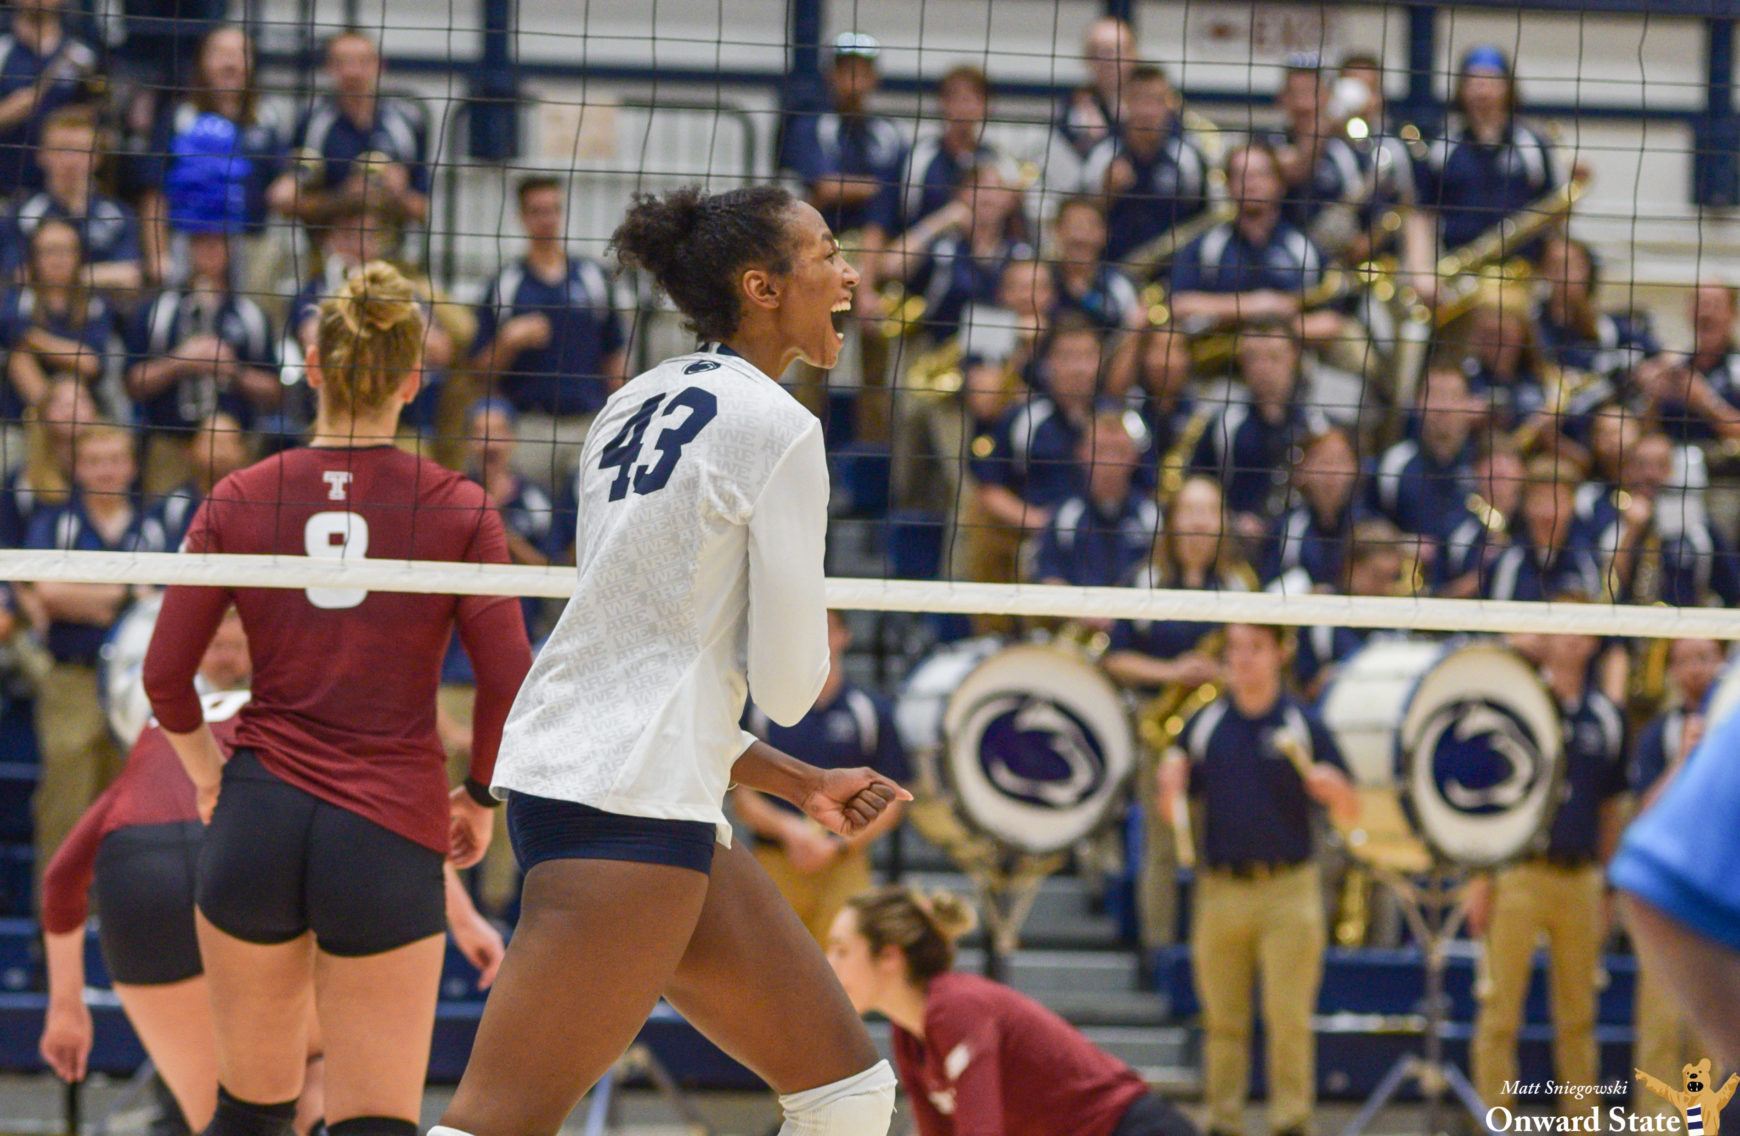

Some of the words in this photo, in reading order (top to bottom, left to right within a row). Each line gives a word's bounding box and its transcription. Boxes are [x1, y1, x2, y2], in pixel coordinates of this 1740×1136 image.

[322, 470, 354, 501] T
[599, 386, 717, 502] 43
[304, 511, 368, 609] 8
